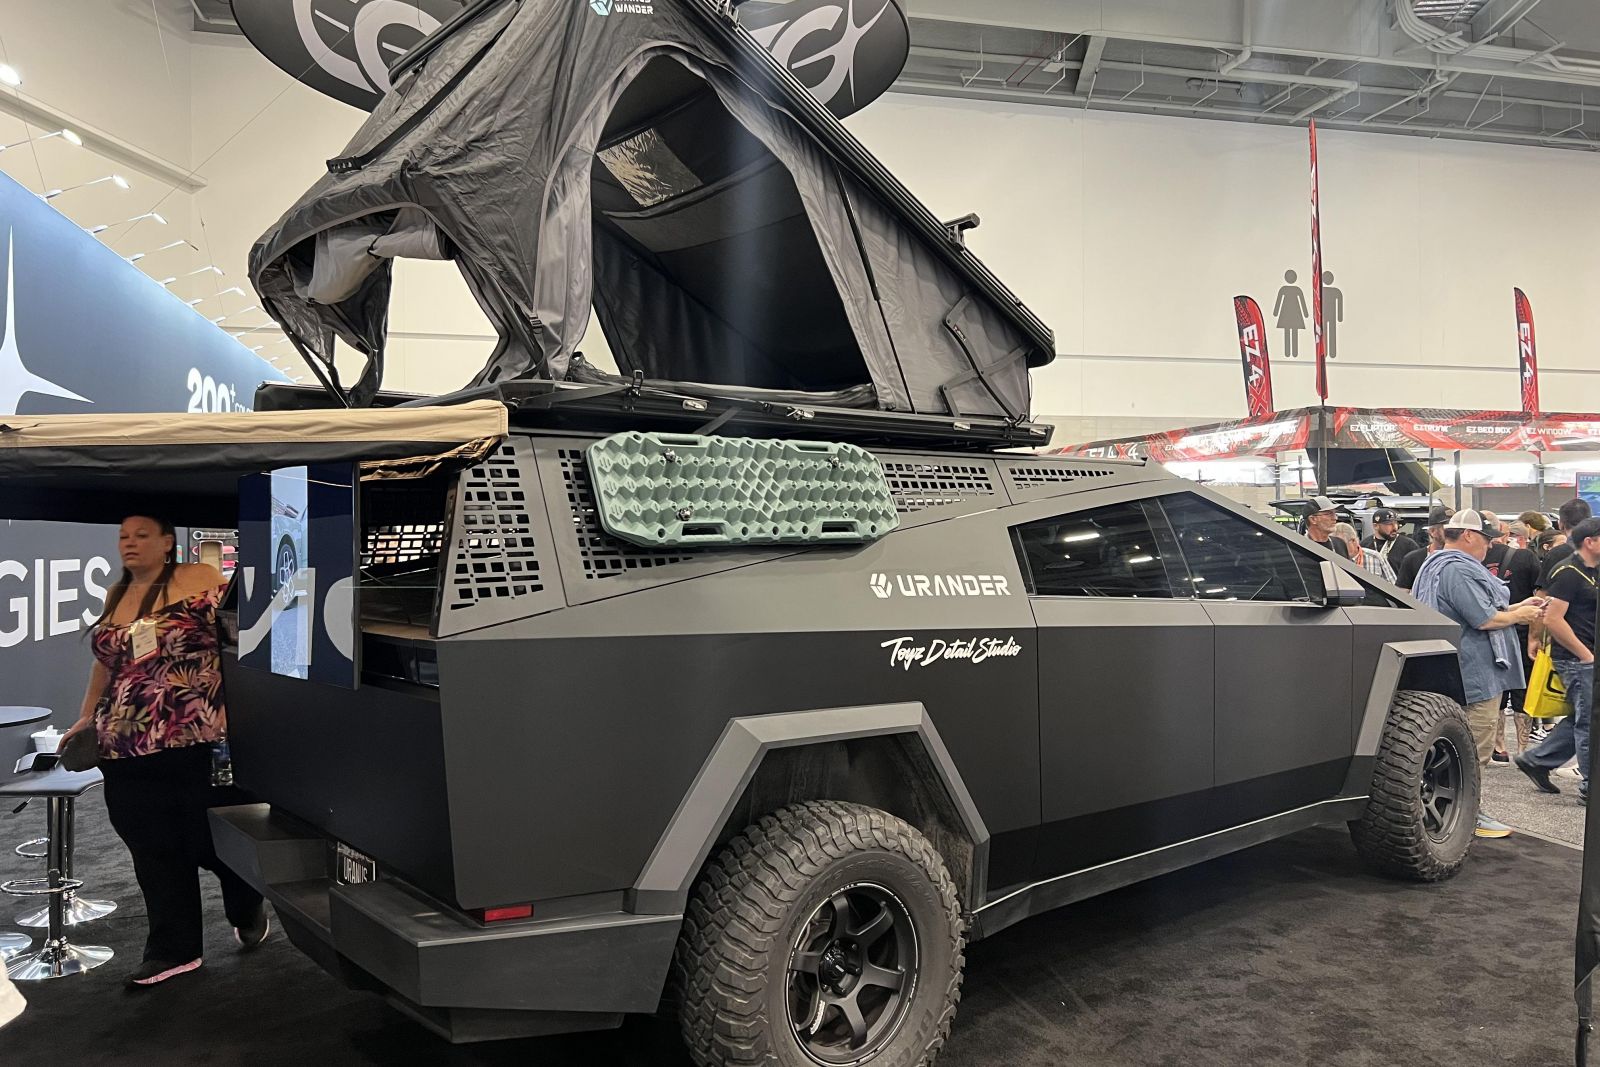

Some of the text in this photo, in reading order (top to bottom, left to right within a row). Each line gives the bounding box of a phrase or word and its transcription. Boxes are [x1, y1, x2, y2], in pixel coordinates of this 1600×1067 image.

[614, 4, 654, 15] WANDER
[1243, 323, 1262, 362] EZ
[1520, 322, 1533, 358] EZ
[896, 574, 1012, 597] URANDER
[881, 635, 1023, 671] Toyz Detail Studio
